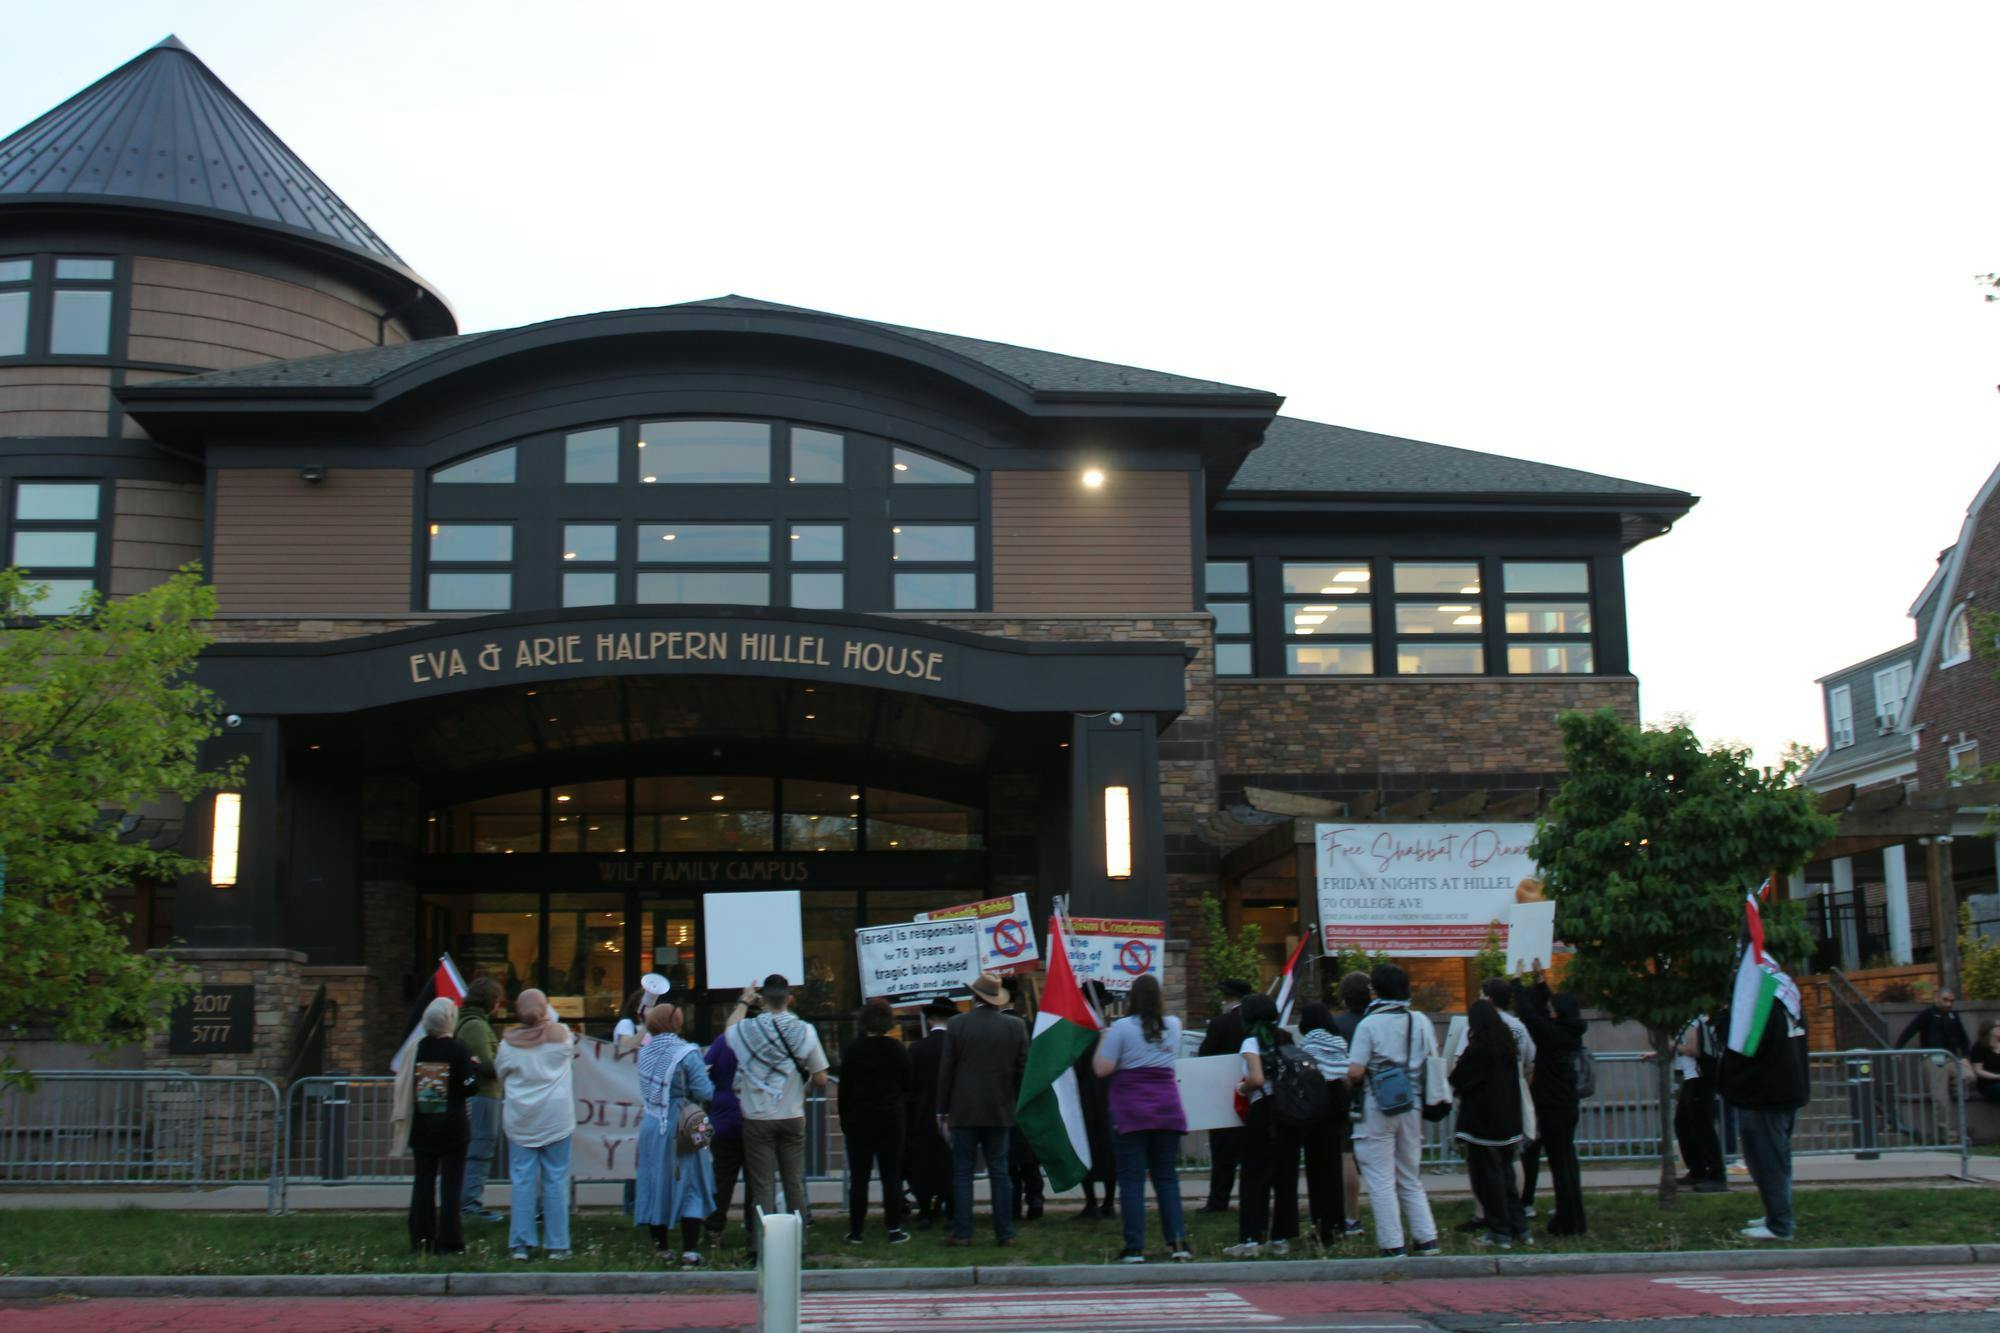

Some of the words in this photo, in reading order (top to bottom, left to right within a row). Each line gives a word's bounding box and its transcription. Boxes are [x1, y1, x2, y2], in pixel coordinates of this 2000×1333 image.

[409, 648, 468, 683] EVA
[514, 635, 585, 669] ARIE
[595, 630, 729, 662] HALPERN
[740, 632, 830, 667] HILLEL
[842, 641, 944, 682] HOUSE
[1320, 828, 1365, 868] Free
[1370, 832, 1459, 873] Shabbat
[1459, 829, 1530, 870] Dinne
[599, 861, 645, 881] WILF
[652, 861, 720, 881] FAMILY
[726, 861, 809, 881] CAMPUS
[1323, 877, 1378, 890] FRIDAY
[1380, 877, 1438, 890] NIGHTS
[1440, 877, 1462, 890] AT
[1463, 877, 1515, 890] HILLEL
[1323, 898, 1337, 909] 70
[1339, 898, 1398, 909] COLLEGE
[1399, 898, 1424, 909] AVE
[861, 930, 893, 945] Israel
[896, 929, 906, 940] is
[910, 923, 975, 941] responsible
[896, 947, 909, 959] 76
[913, 946, 945, 960] years
[1090, 950, 1103, 960] of
[875, 966, 908, 981] tragic
[912, 959, 969, 975] bloodshed
[887, 984, 896, 993] of
[899, 982, 920, 991] Arab
[941, 979, 960, 987] Jew
[192, 994, 232, 1012] 2017
[191, 1025, 232, 1043] 5777
